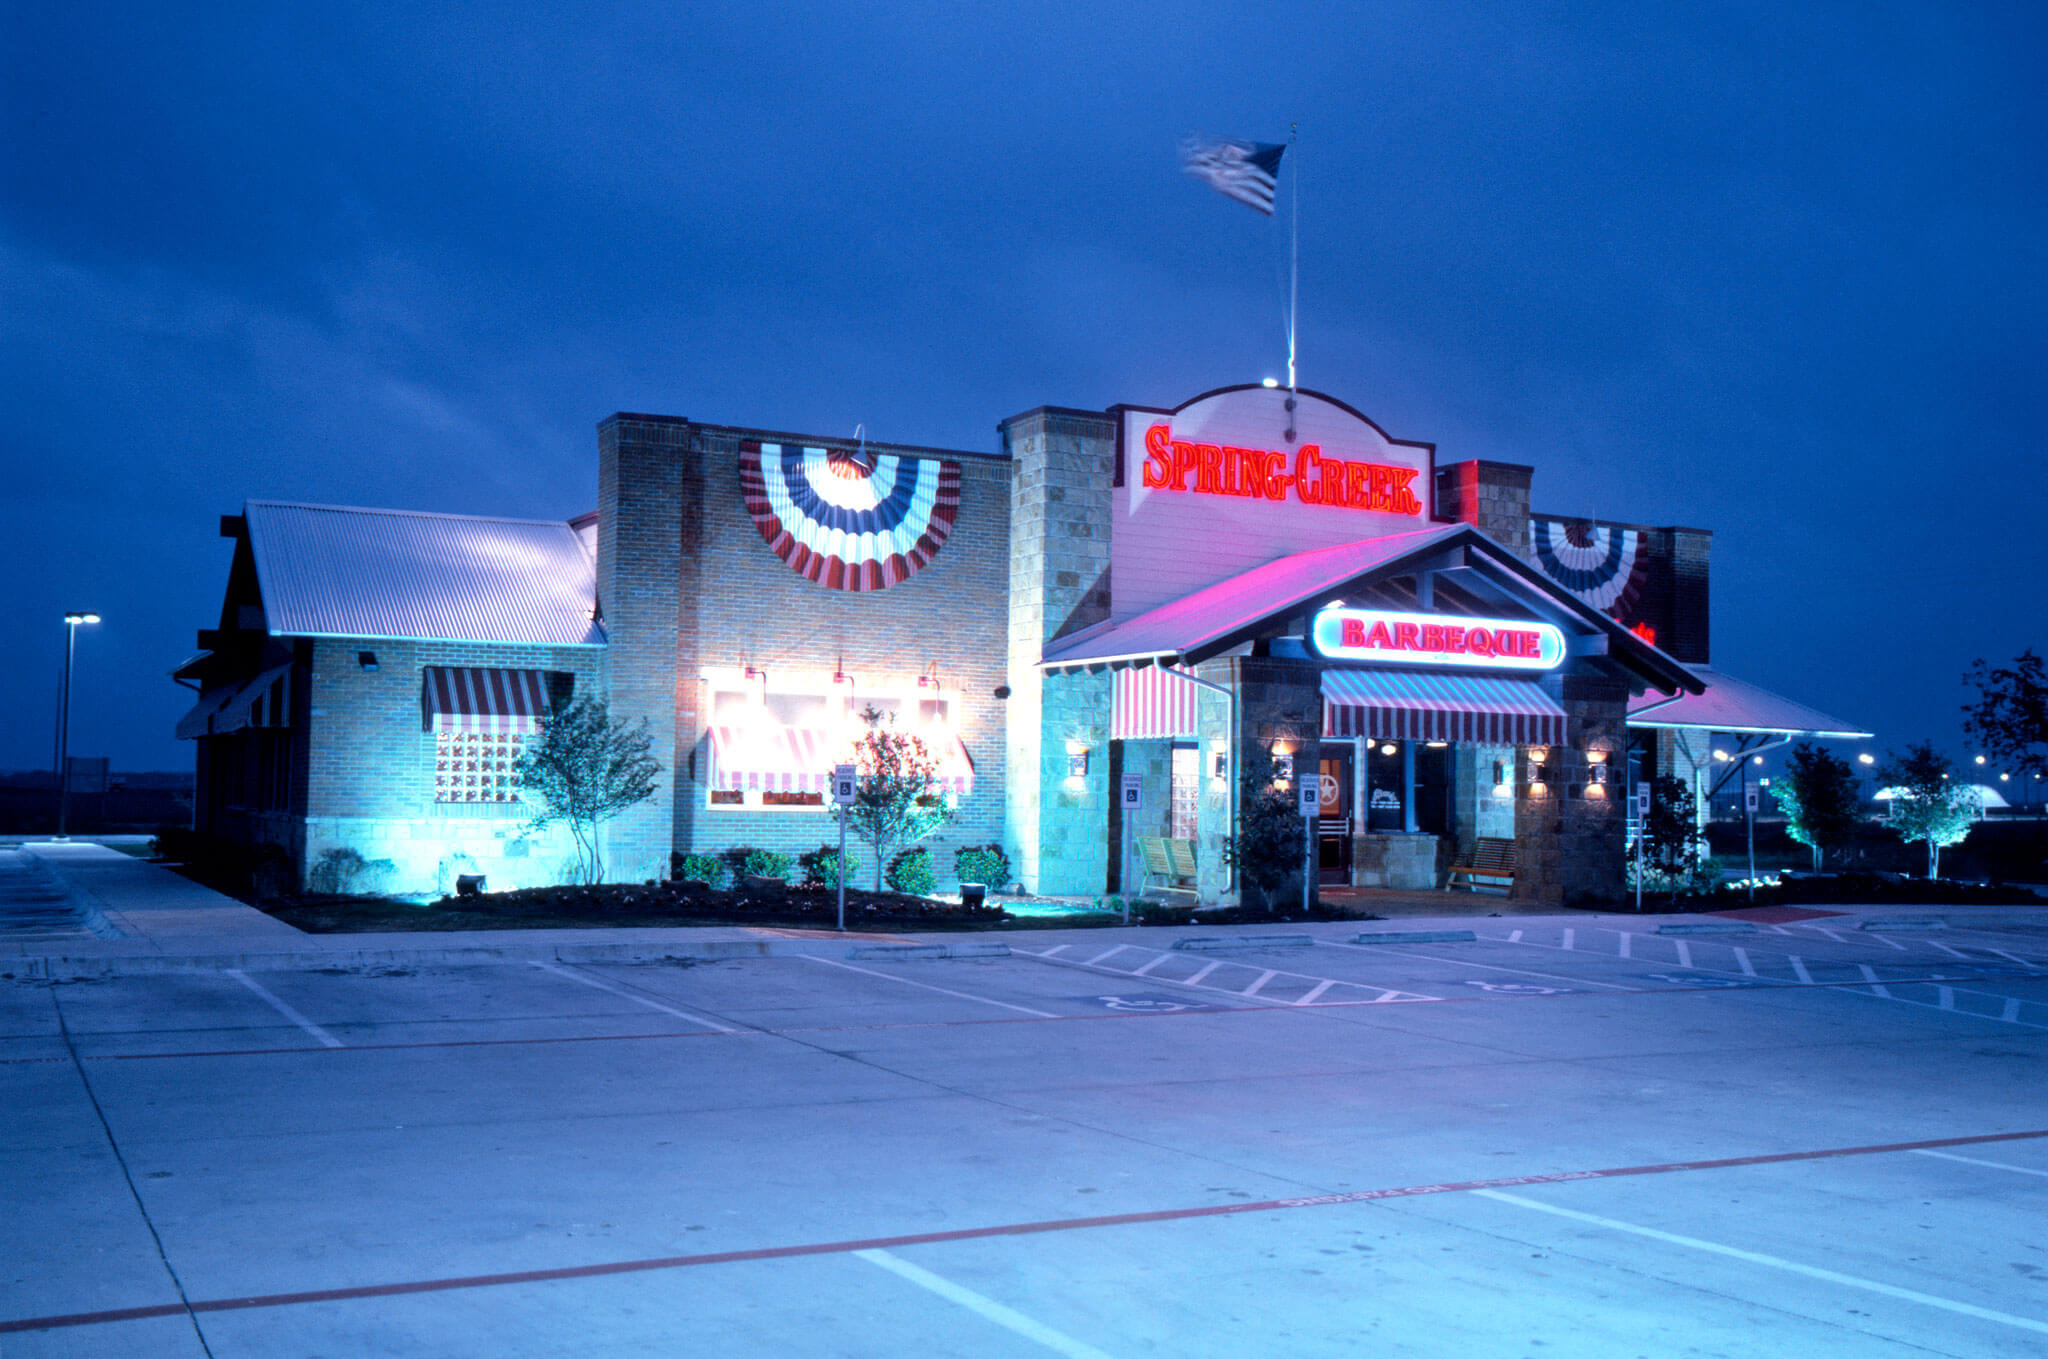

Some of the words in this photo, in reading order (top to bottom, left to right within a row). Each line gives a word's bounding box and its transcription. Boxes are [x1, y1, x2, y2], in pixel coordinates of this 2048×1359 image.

[1143, 424, 1292, 501] SPRING
[1296, 443, 1422, 516] CREEK
[1341, 617, 1541, 658] BARBEQUE
